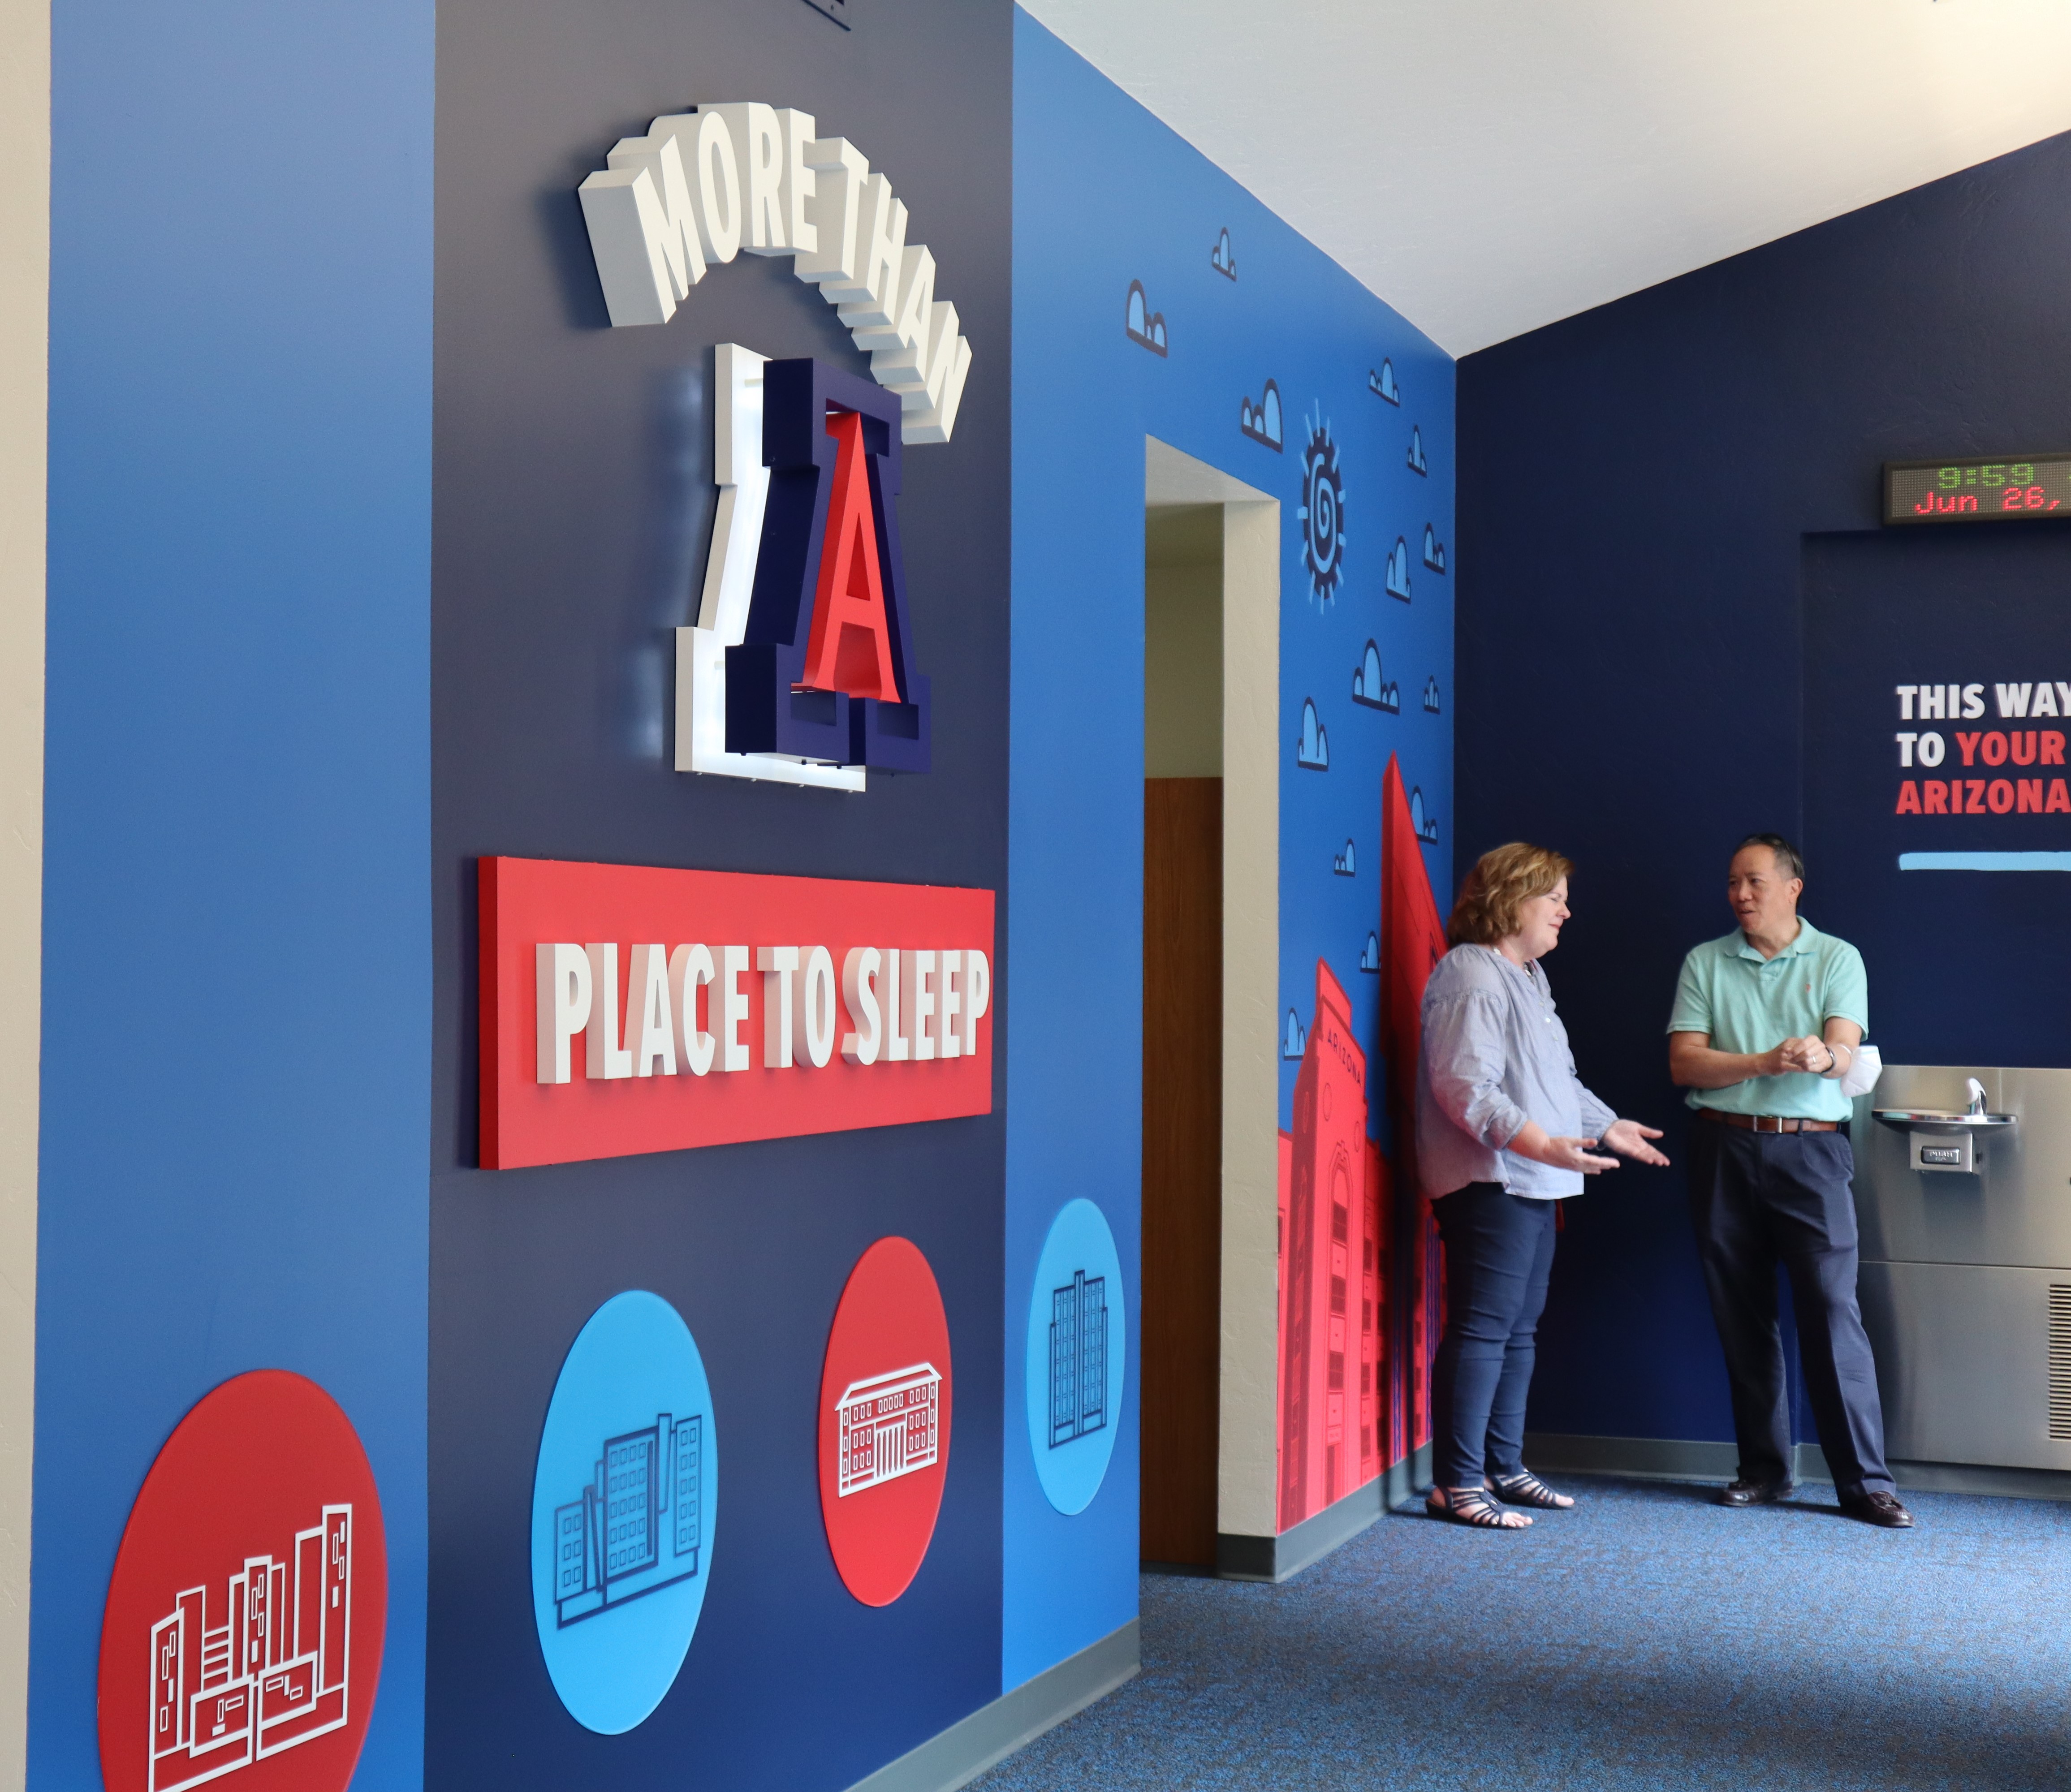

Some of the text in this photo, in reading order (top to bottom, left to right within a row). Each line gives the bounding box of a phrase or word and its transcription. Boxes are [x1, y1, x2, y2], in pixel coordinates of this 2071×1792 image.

[630, 102, 972, 443] MORE THAN
[1938, 463, 2035, 489] 9:59
[1915, 486, 2061, 514] Jun 26,
[1896, 683, 1986, 720] THIS
[1895, 730, 2067, 767] TO YOUR
[1895, 778, 2071, 814] ARIZONA
[536, 943, 990, 1084] PLACE TO SLEEP
[1327, 1028, 1362, 1088] ARIZONA
